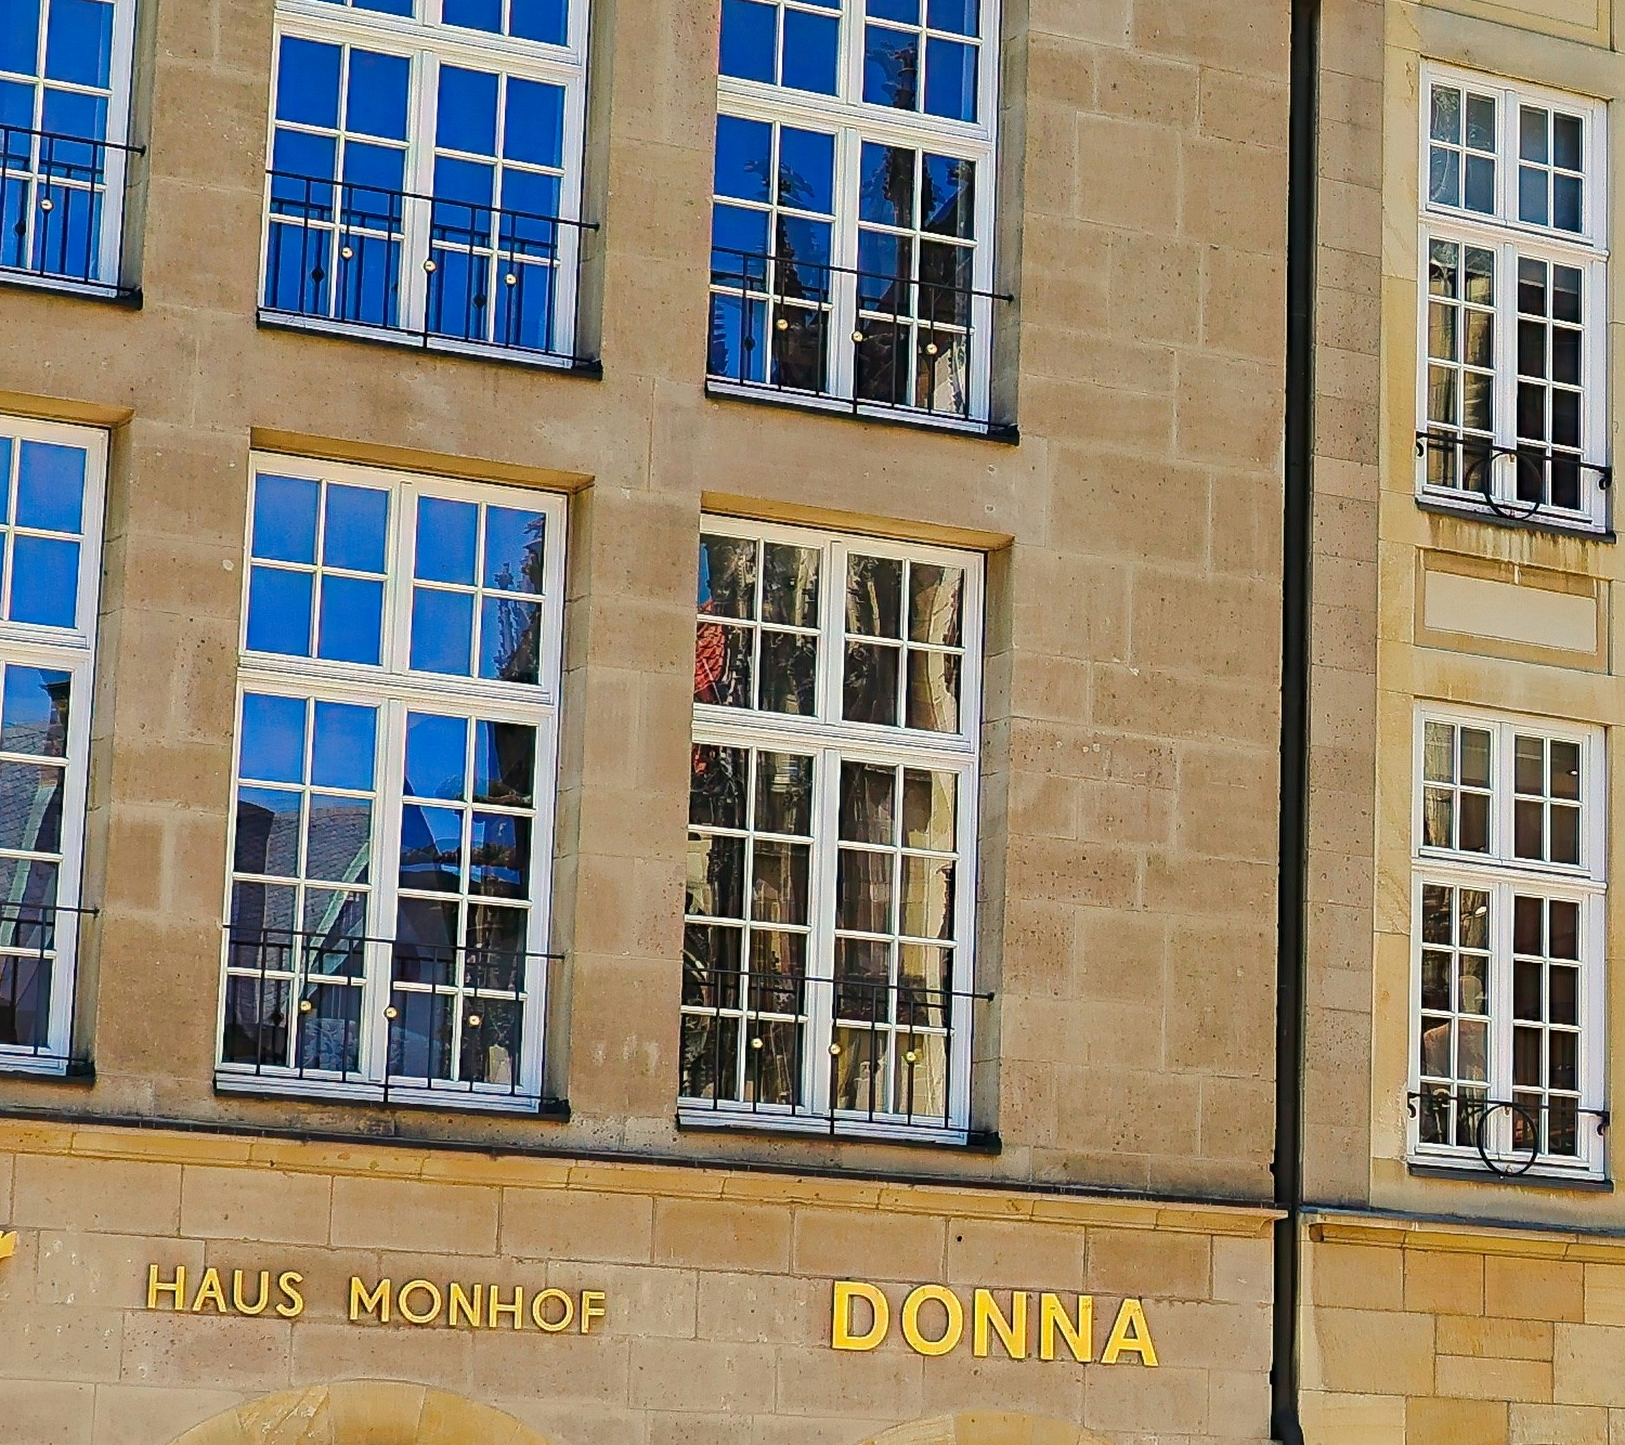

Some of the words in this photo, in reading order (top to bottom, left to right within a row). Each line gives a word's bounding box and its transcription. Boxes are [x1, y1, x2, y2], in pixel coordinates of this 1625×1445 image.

[146, 1263, 305, 1318] HAUS
[348, 1276, 606, 1334] MONHOF
[831, 1280, 1160, 1367] DONNA
